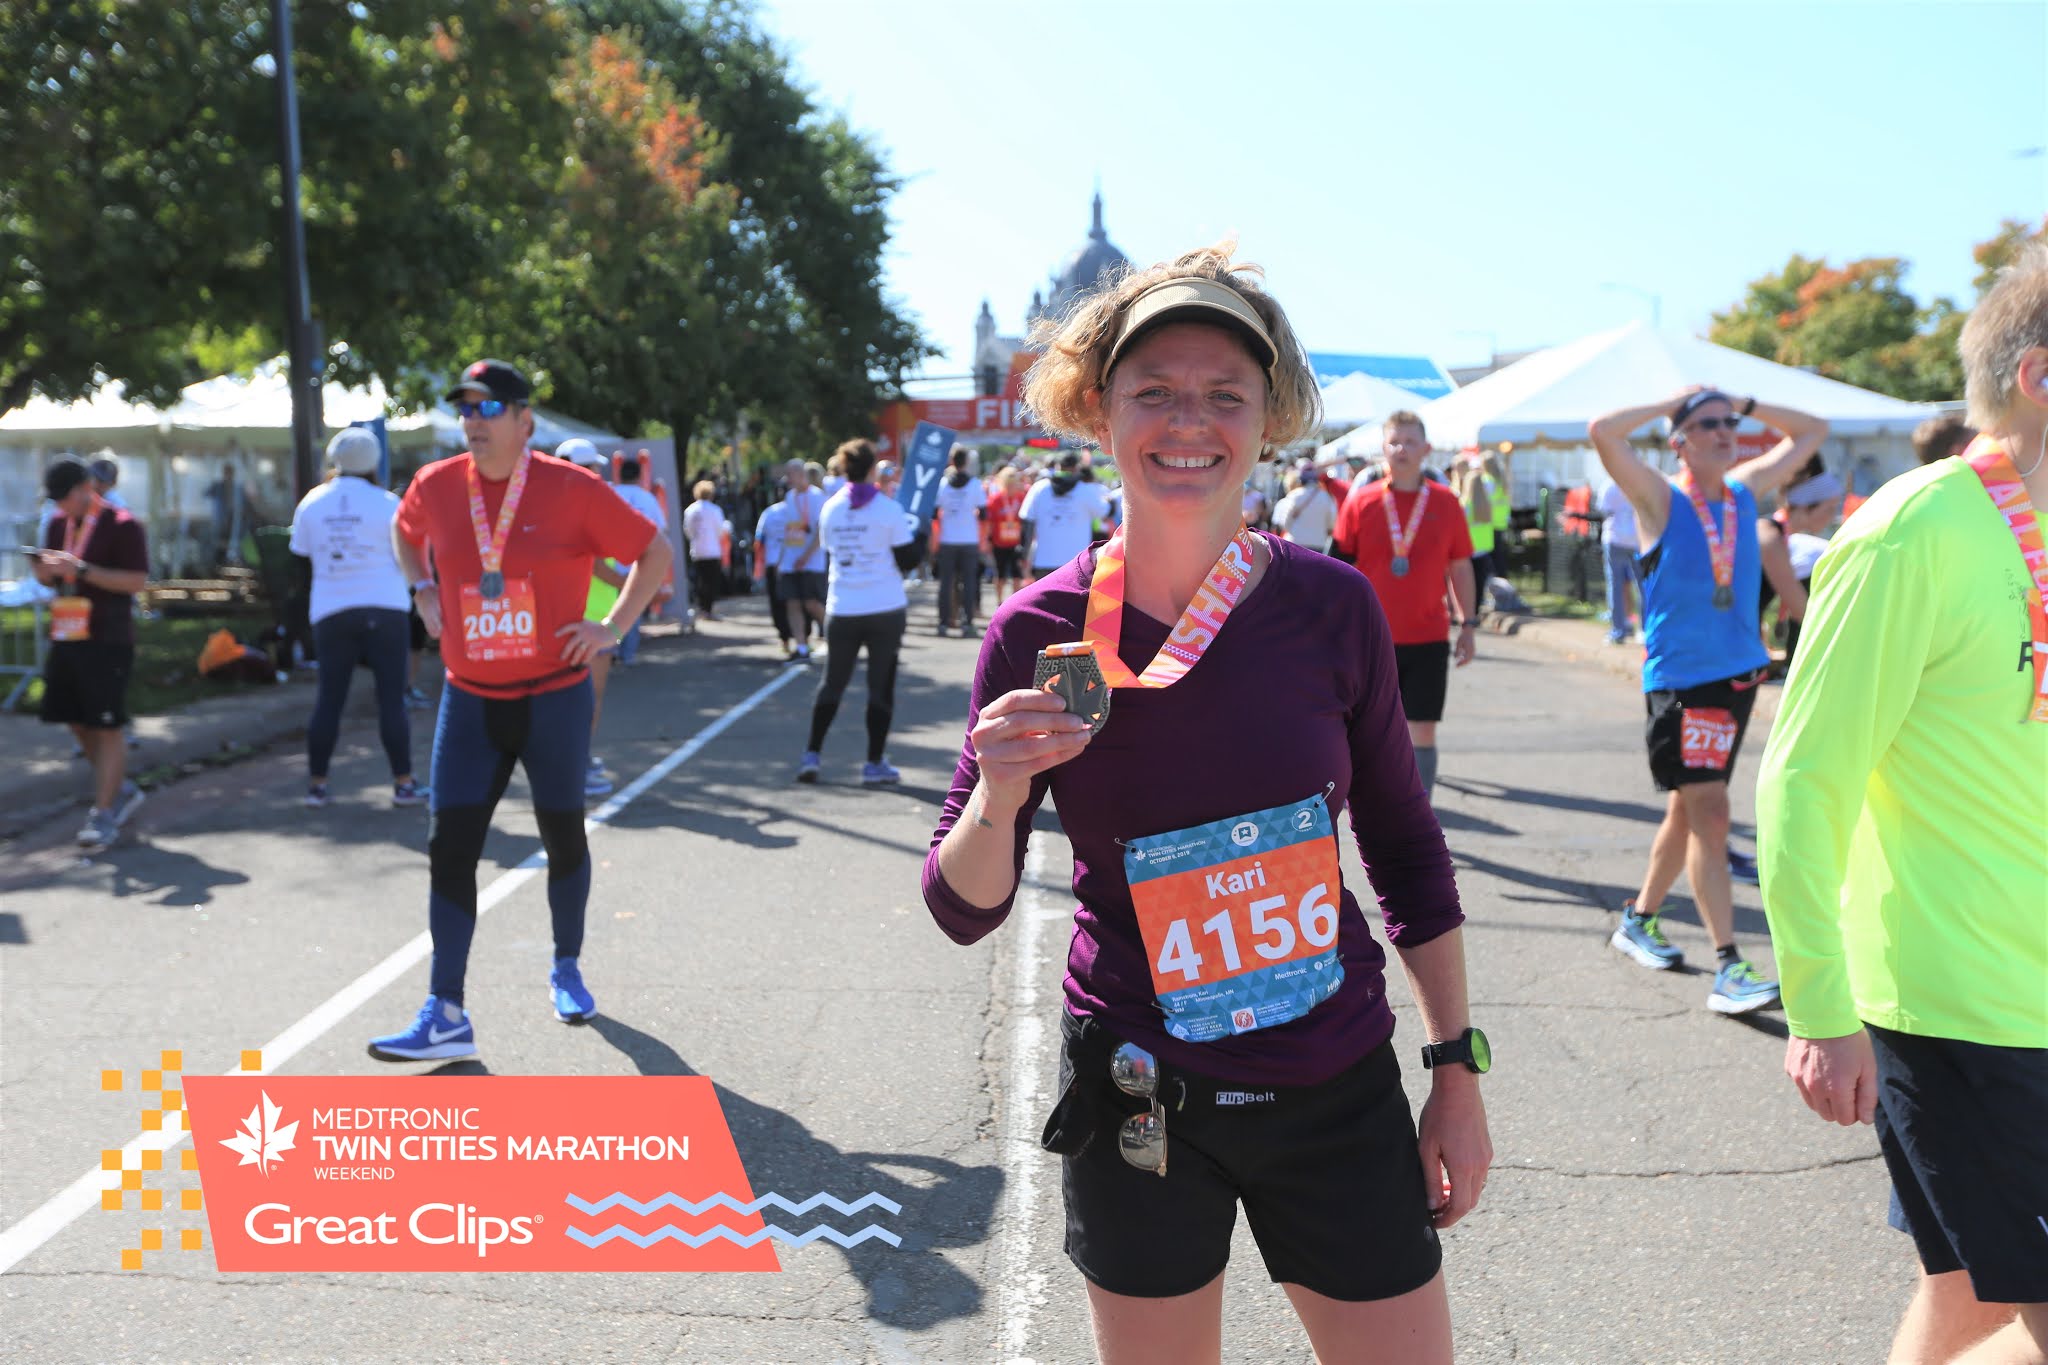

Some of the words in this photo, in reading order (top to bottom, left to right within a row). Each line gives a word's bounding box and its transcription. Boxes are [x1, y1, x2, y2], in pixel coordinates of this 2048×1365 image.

[463, 610, 533, 640] 2040
[1297, 811, 1313, 829] 2
[1161, 848, 1177, 856] CITIES
[1177, 840, 1206, 851] MARATHON
[1149, 854, 1172, 865] OCTOBER
[1177, 850, 1190, 858] 2019
[1205, 861, 1266, 900] Kari
[1157, 883, 1338, 982] 4156
[1274, 967, 1307, 981] Medtronic
[1216, 1091, 1276, 1105] FlipBelt
